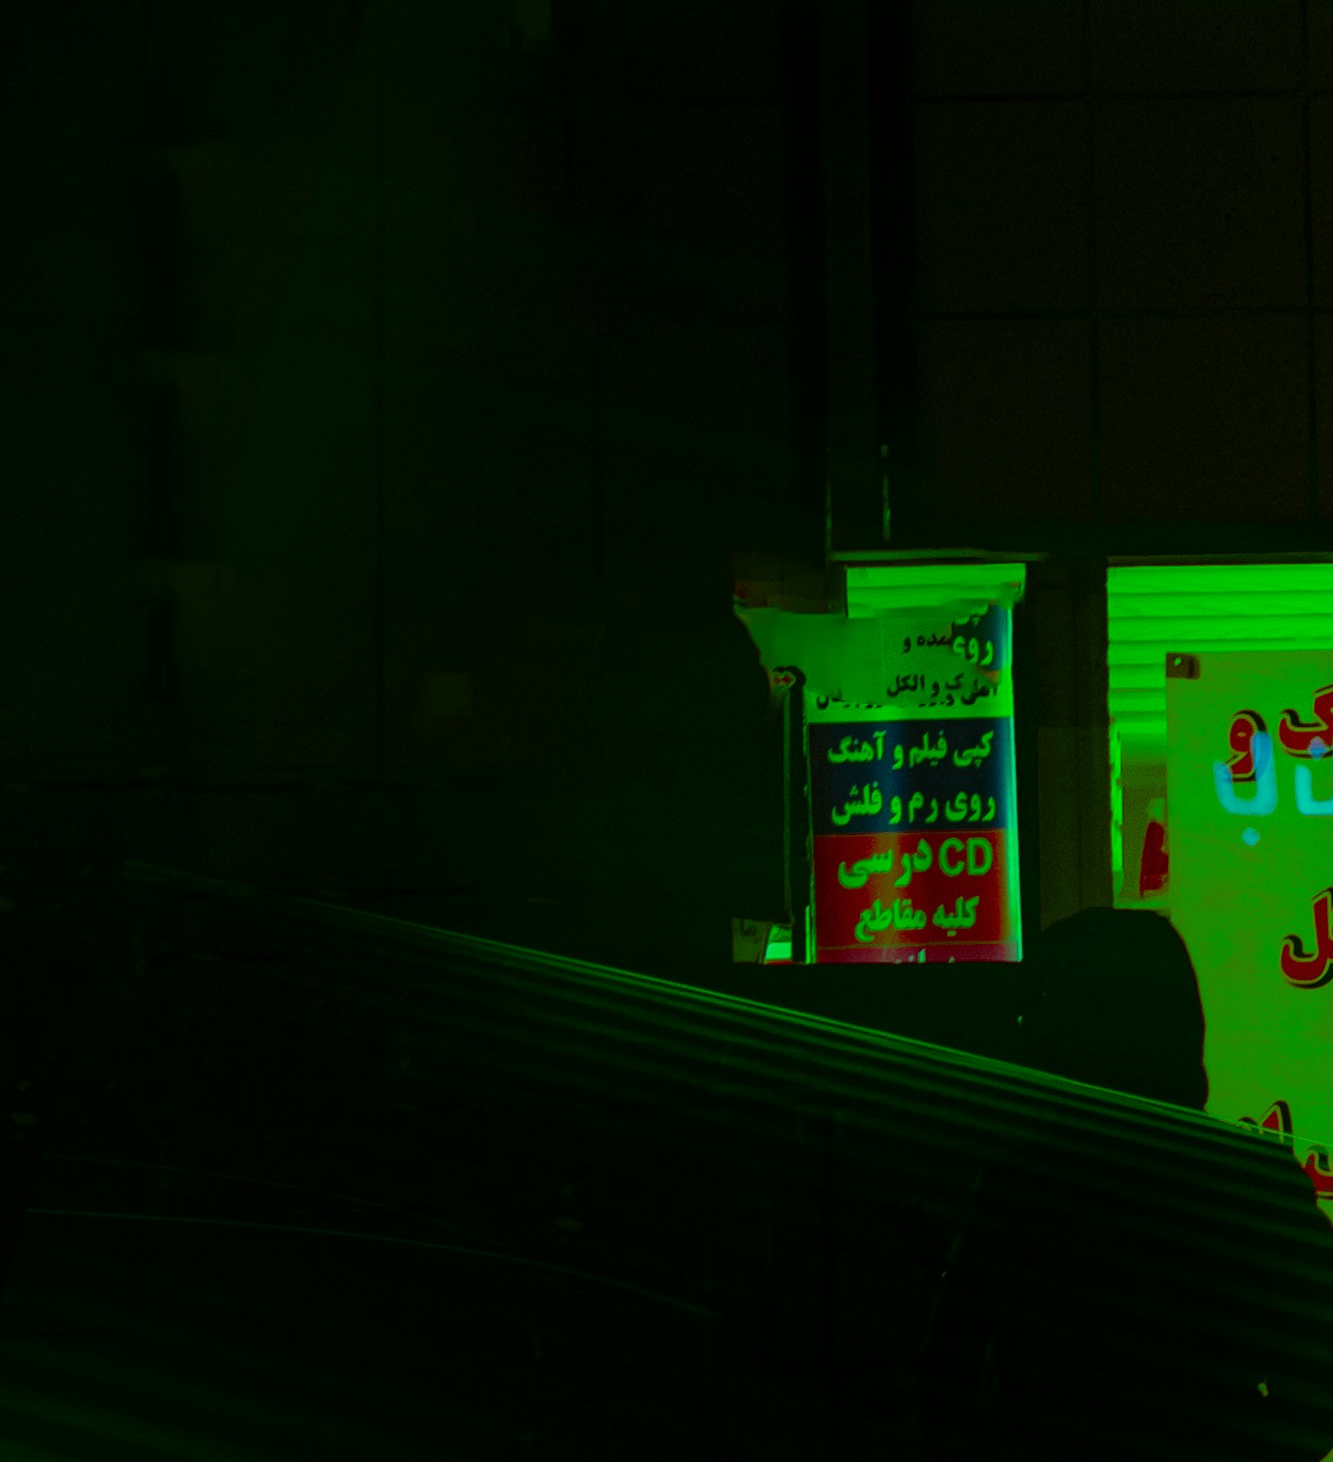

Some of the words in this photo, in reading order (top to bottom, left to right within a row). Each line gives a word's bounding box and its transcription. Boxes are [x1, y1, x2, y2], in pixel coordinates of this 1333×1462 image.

[886, 673, 925, 697] الکل
[827, 730, 886, 764] آهنگ
[892, 744, 904, 770] و
[909, 730, 948, 768] فیلم
[953, 730, 994, 769] کپی
[1225, 710, 1268, 783] و
[832, 781, 883, 826] فلش
[889, 795, 902, 825] و
[908, 791, 938, 823] رم
[945, 791, 996, 822] روی
[837, 838, 933, 889] درسی
[938, 837, 993, 877] CD
[855, 899, 927, 942] مقاطع
[932, 896, 979, 936] کلیه
